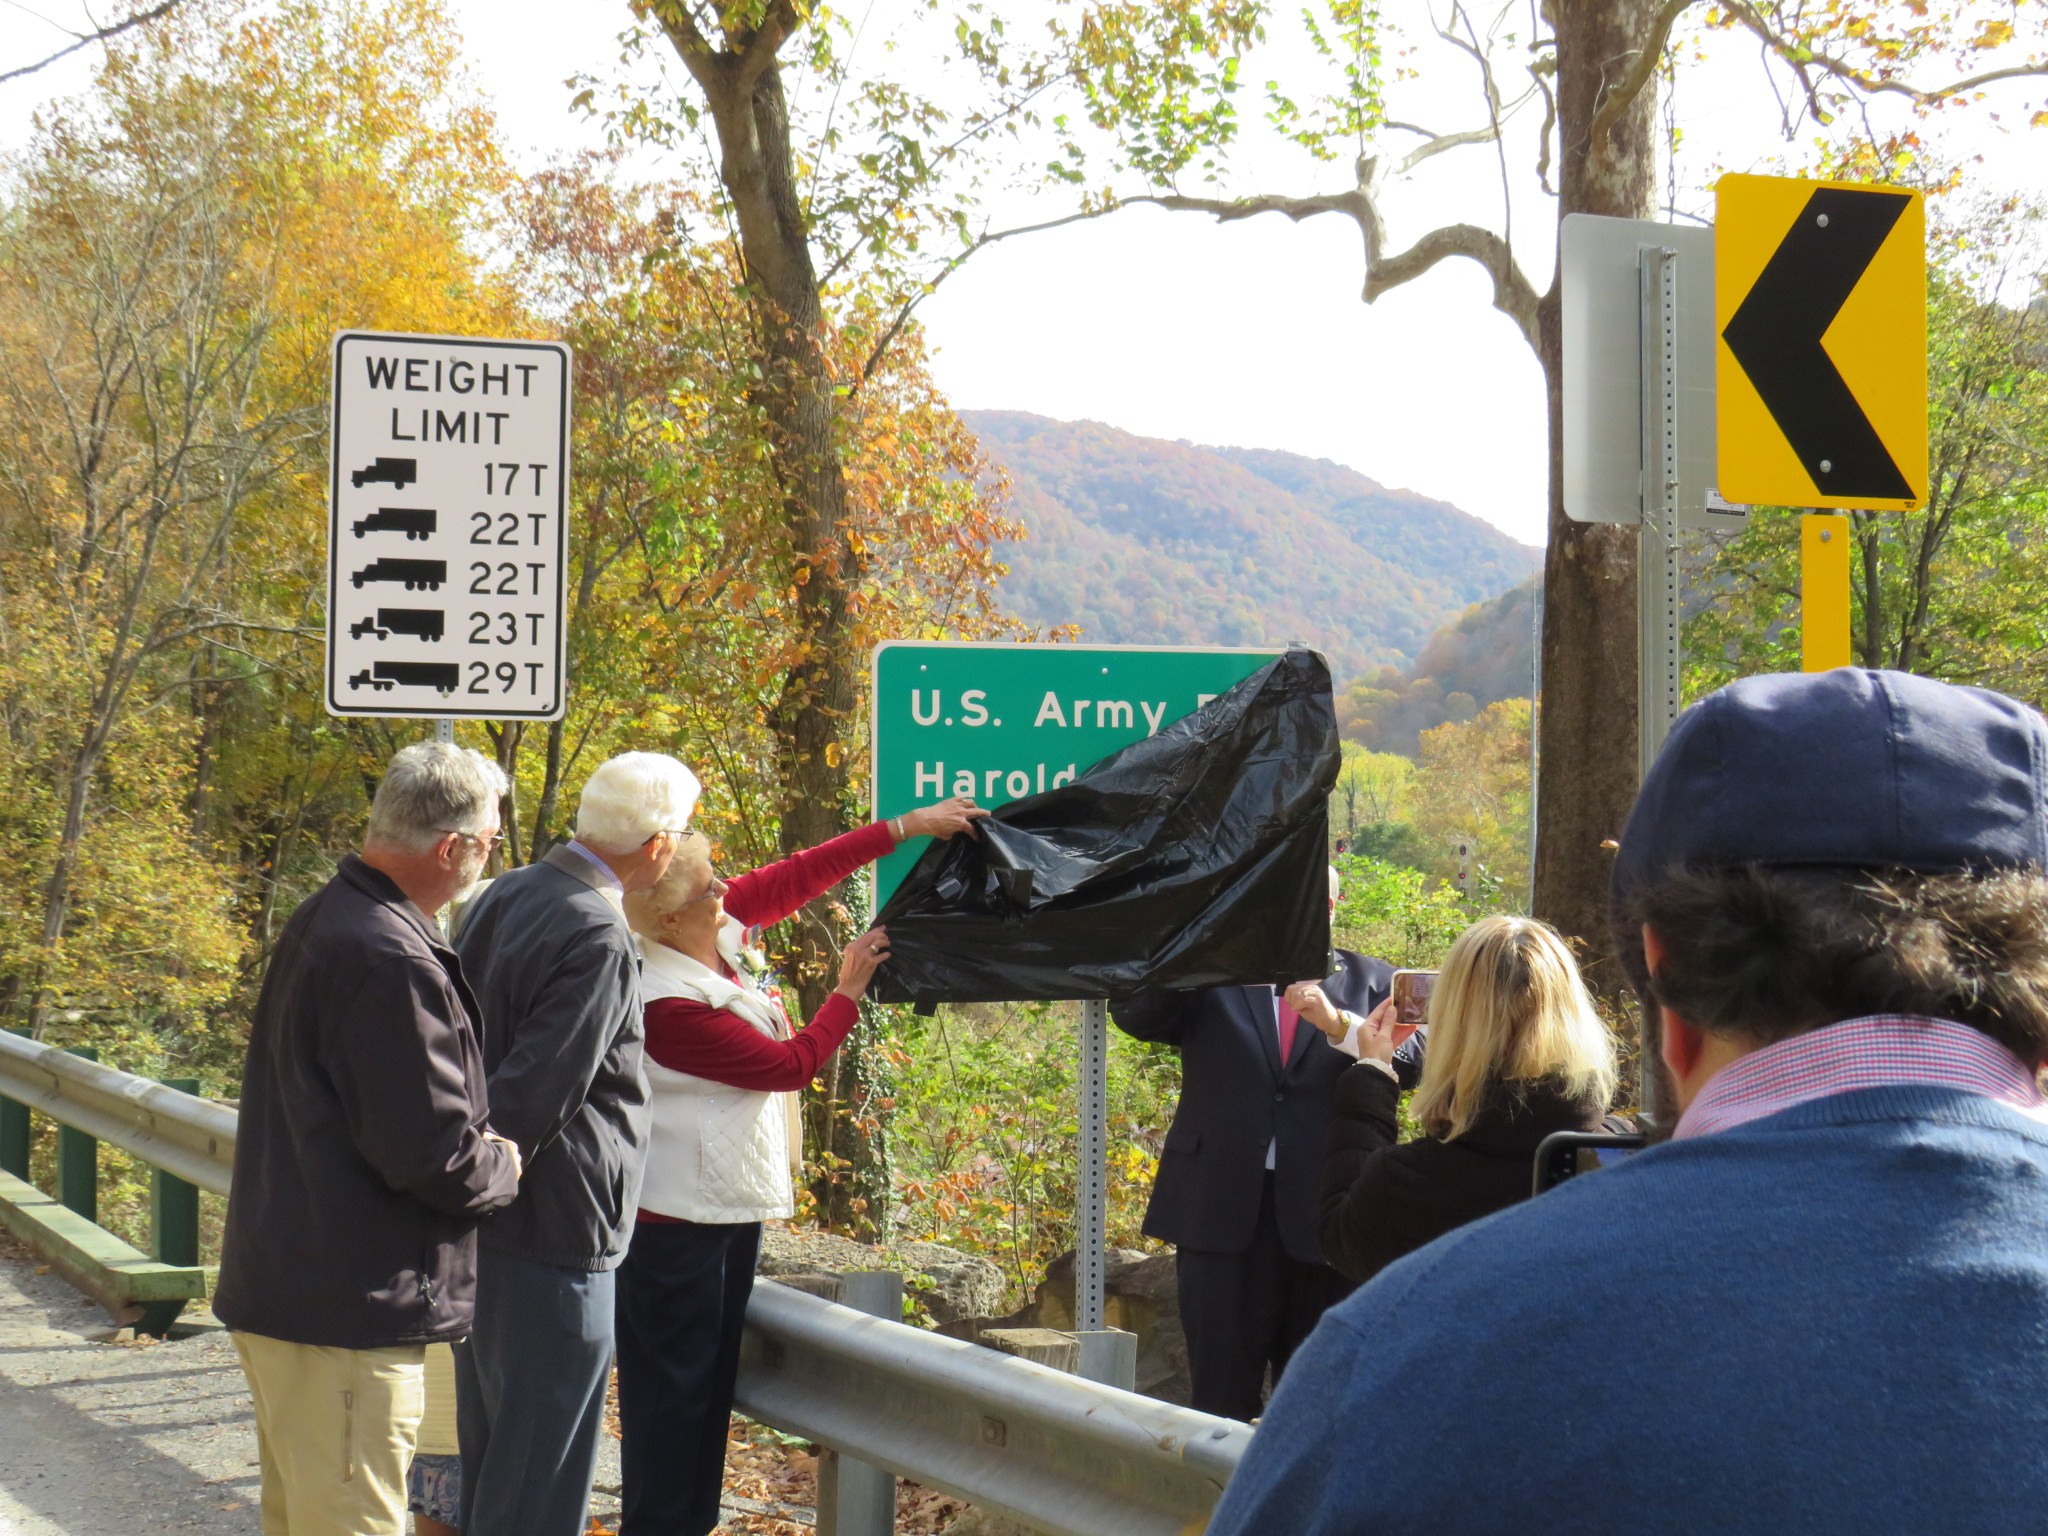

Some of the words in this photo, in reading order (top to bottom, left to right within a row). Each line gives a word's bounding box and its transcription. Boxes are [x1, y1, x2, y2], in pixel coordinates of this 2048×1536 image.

[366, 356, 538, 397] WEIGHT
[392, 408, 509, 445] LIMIT
[485, 463, 548, 496] 17T
[470, 512, 547, 546] 22T
[469, 561, 546, 595] 22T
[468, 612, 545, 646] 23T
[467, 661, 544, 695] 29T
[911, 689, 1002, 727] U.S.
[1034, 691, 1167, 737] Army
[915, 761, 1076, 798] Harold
